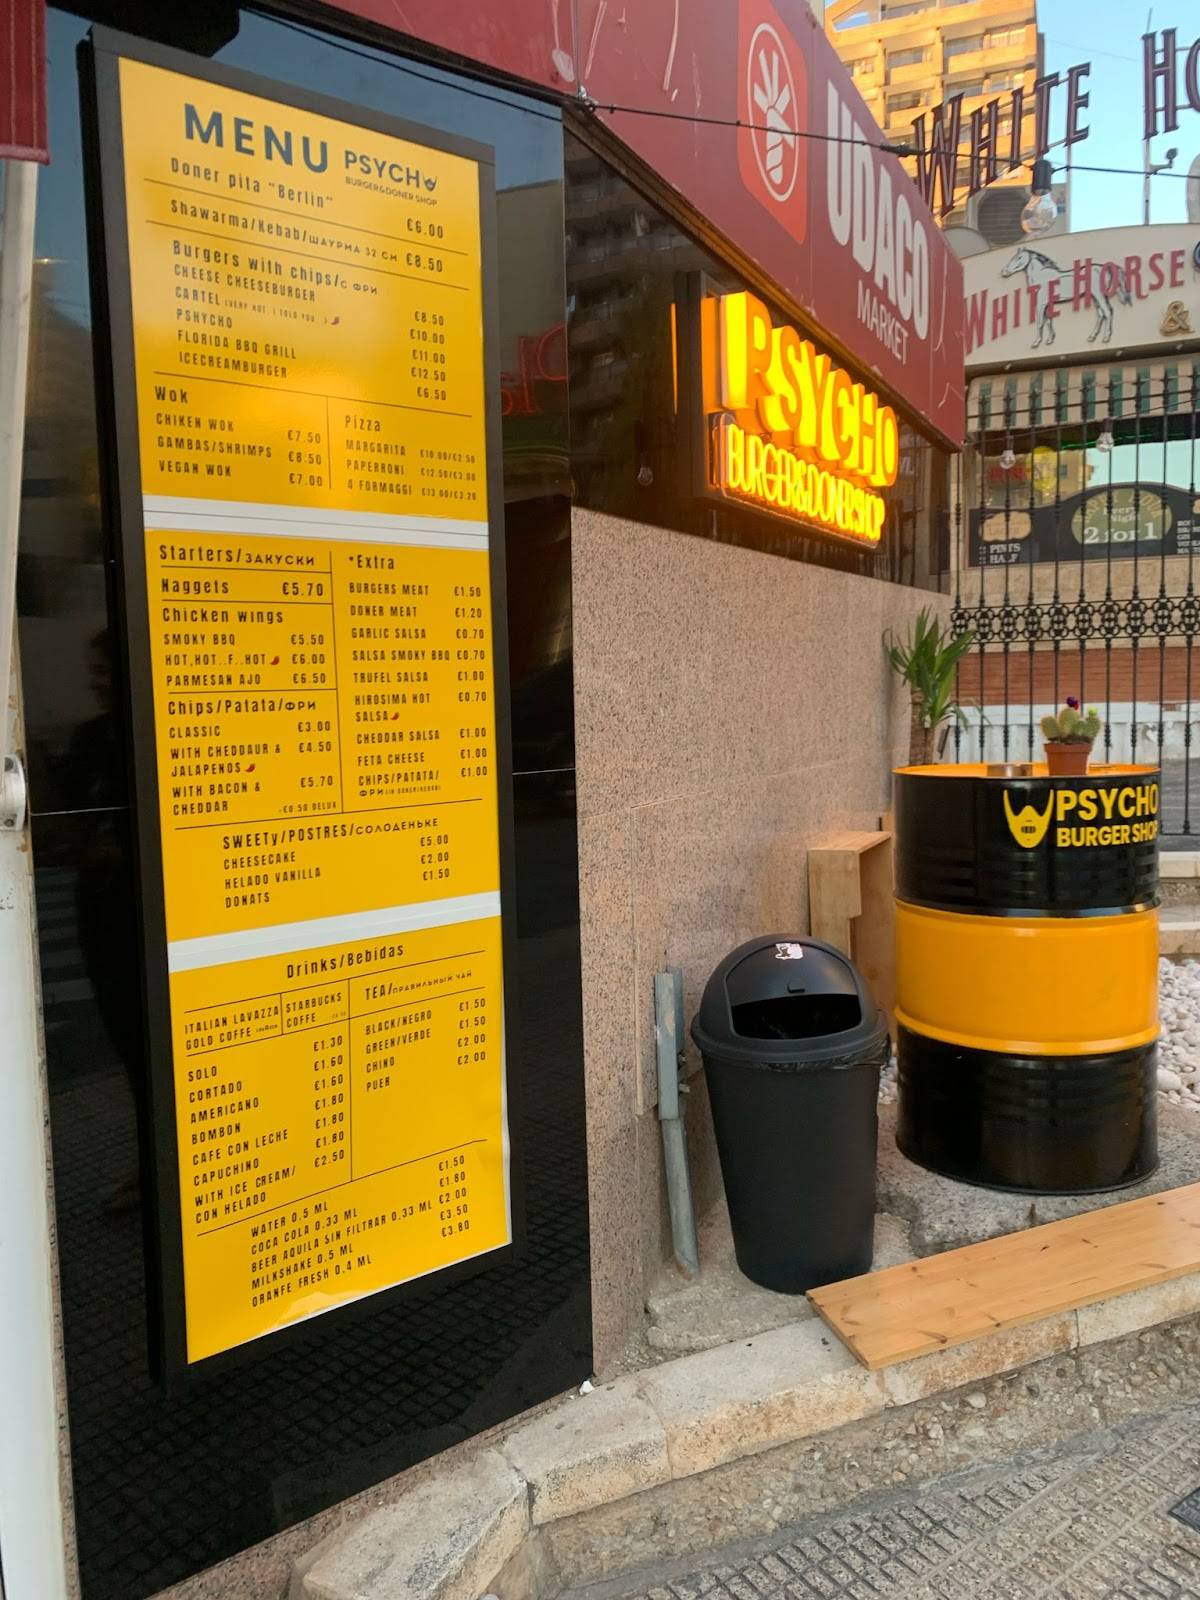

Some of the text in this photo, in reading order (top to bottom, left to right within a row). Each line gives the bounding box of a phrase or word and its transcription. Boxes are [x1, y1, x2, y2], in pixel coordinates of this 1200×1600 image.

[184, 102, 328, 174] MENU
[911, 62, 1091, 218] WHITE
[171, 157, 260, 193] Doner pita
[827, 78, 929, 341] UDACO
[173, 240, 282, 276] Burgers with
[174, 264, 316, 301] CHEESE CHEESEBURGER
[175, 286, 221, 306] CARTEL
[963, 279, 1060, 355] WHITE
[1073, 250, 1185, 314] HORSE
[176, 308, 233, 328] PSHYCHO
[857, 279, 909, 365] MARKET
[1158, 300, 1196, 337] &
[177, 329, 296, 359] FLORIDA BBQ GRILL
[179, 351, 287, 378] ICECREAMBURGER
[154, 385, 188, 403] Wok
[719, 290, 899, 488] PSYCHO
[156, 412, 234, 432] CHIKEN WOK
[345, 415, 381, 432] Pizza
[157, 435, 272, 458] GAMBAS/SHRIMPS
[346, 439, 406, 456] MARGARITA
[159, 460, 232, 477] VEGAN WOK
[346, 459, 404, 475] PAPERRONI
[359, 480, 412, 496] FORMAGGI
[1083, 526, 1100, 544] 2
[1143, 522, 1158, 540] 1
[161, 578, 324, 596] Naggets €5.70
[349, 582, 429, 596] BURGERS MEAT
[162, 607, 283, 624] Chicken wings
[350, 605, 417, 617] DONER MEAT
[163, 634, 324, 645] SMOKY BBQ €5.50
[351, 628, 426, 639] GARLIC SALSA
[352, 650, 450, 661] SALSA SMOKY BBQ
[166, 673, 326, 686] PARMESAN AJO €6.50
[353, 671, 429, 683] TRUFEL SALSA
[354, 693, 430, 705] HIROSIMA HOT
[169, 721, 331, 738] CLASSIC €3.00
[355, 711, 389, 722] SALSA
[171, 747, 201, 759] WITH
[275, 744, 280, 754] &
[298, 741, 332, 753] €4.50
[356, 729, 440, 744] CHEDDAR SALSA
[171, 762, 241, 777] JALAPENOS
[358, 752, 425, 767] FETA CHEESE
[172, 775, 333, 798] WITH BACON & €5.70
[358, 770, 440, 786] CHIPS/PATATA/
[173, 801, 229, 816] CHEDDAR
[1056, 783, 1159, 821] PSYCHO
[1056, 824, 1131, 848] BURGER
[223, 834, 449, 870] CHEESECAKE €5.00
[225, 851, 449, 889] HELADO VANILLA €2.00
[225, 868, 450, 908] DONATS €1.50
[287, 945, 404, 978] Drinks/Bebidas
[286, 992, 342, 1013] STARBUCKS
[185, 1006, 279, 1034] ITALIAN LAVAZZA
[286, 1013, 316, 1028] COFFE
[365, 1010, 432, 1035] BLACK/NEGRO
[459, 998, 486, 1012] €1.50
[186, 1035, 213, 1050] GOLD
[219, 1027, 251, 1043] COFFE
[366, 1016, 486, 1054] GREEN/VERDE €1.50
[188, 1035, 343, 1082] SOLO €1.30
[366, 1033, 486, 1073] CHINO €2.00
[189, 1054, 343, 1103] CORTADO €1.60
[366, 1051, 486, 1092] PUER €2.00
[190, 1074, 344, 1124] AMERICANO €1.60
[191, 1093, 344, 1145] BOMBON €1.80
[192, 1112, 344, 1166] CAFE CON LECHE €1.80
[193, 1131, 345, 1187] CAPUCHINO €1.80
[195, 1149, 345, 1207] WITH ICE CREAM/ €2.50
[195, 1192, 266, 1224] CON HELADO
[251, 1155, 465, 1238] WATER 0.5 ML €1.50
[251, 1171, 466, 1256] COCA COLA 0.33 ML €1.80
[251, 1187, 467, 1273] BEER AQUILA SIN FILTRAR 0.33 ML €2.00
[251, 1204, 468, 1290] MILKSHAKE 0.5 ML €3.50
[252, 1220, 470, 1307] ORANFE FRESH 0.4 ML €3.80
